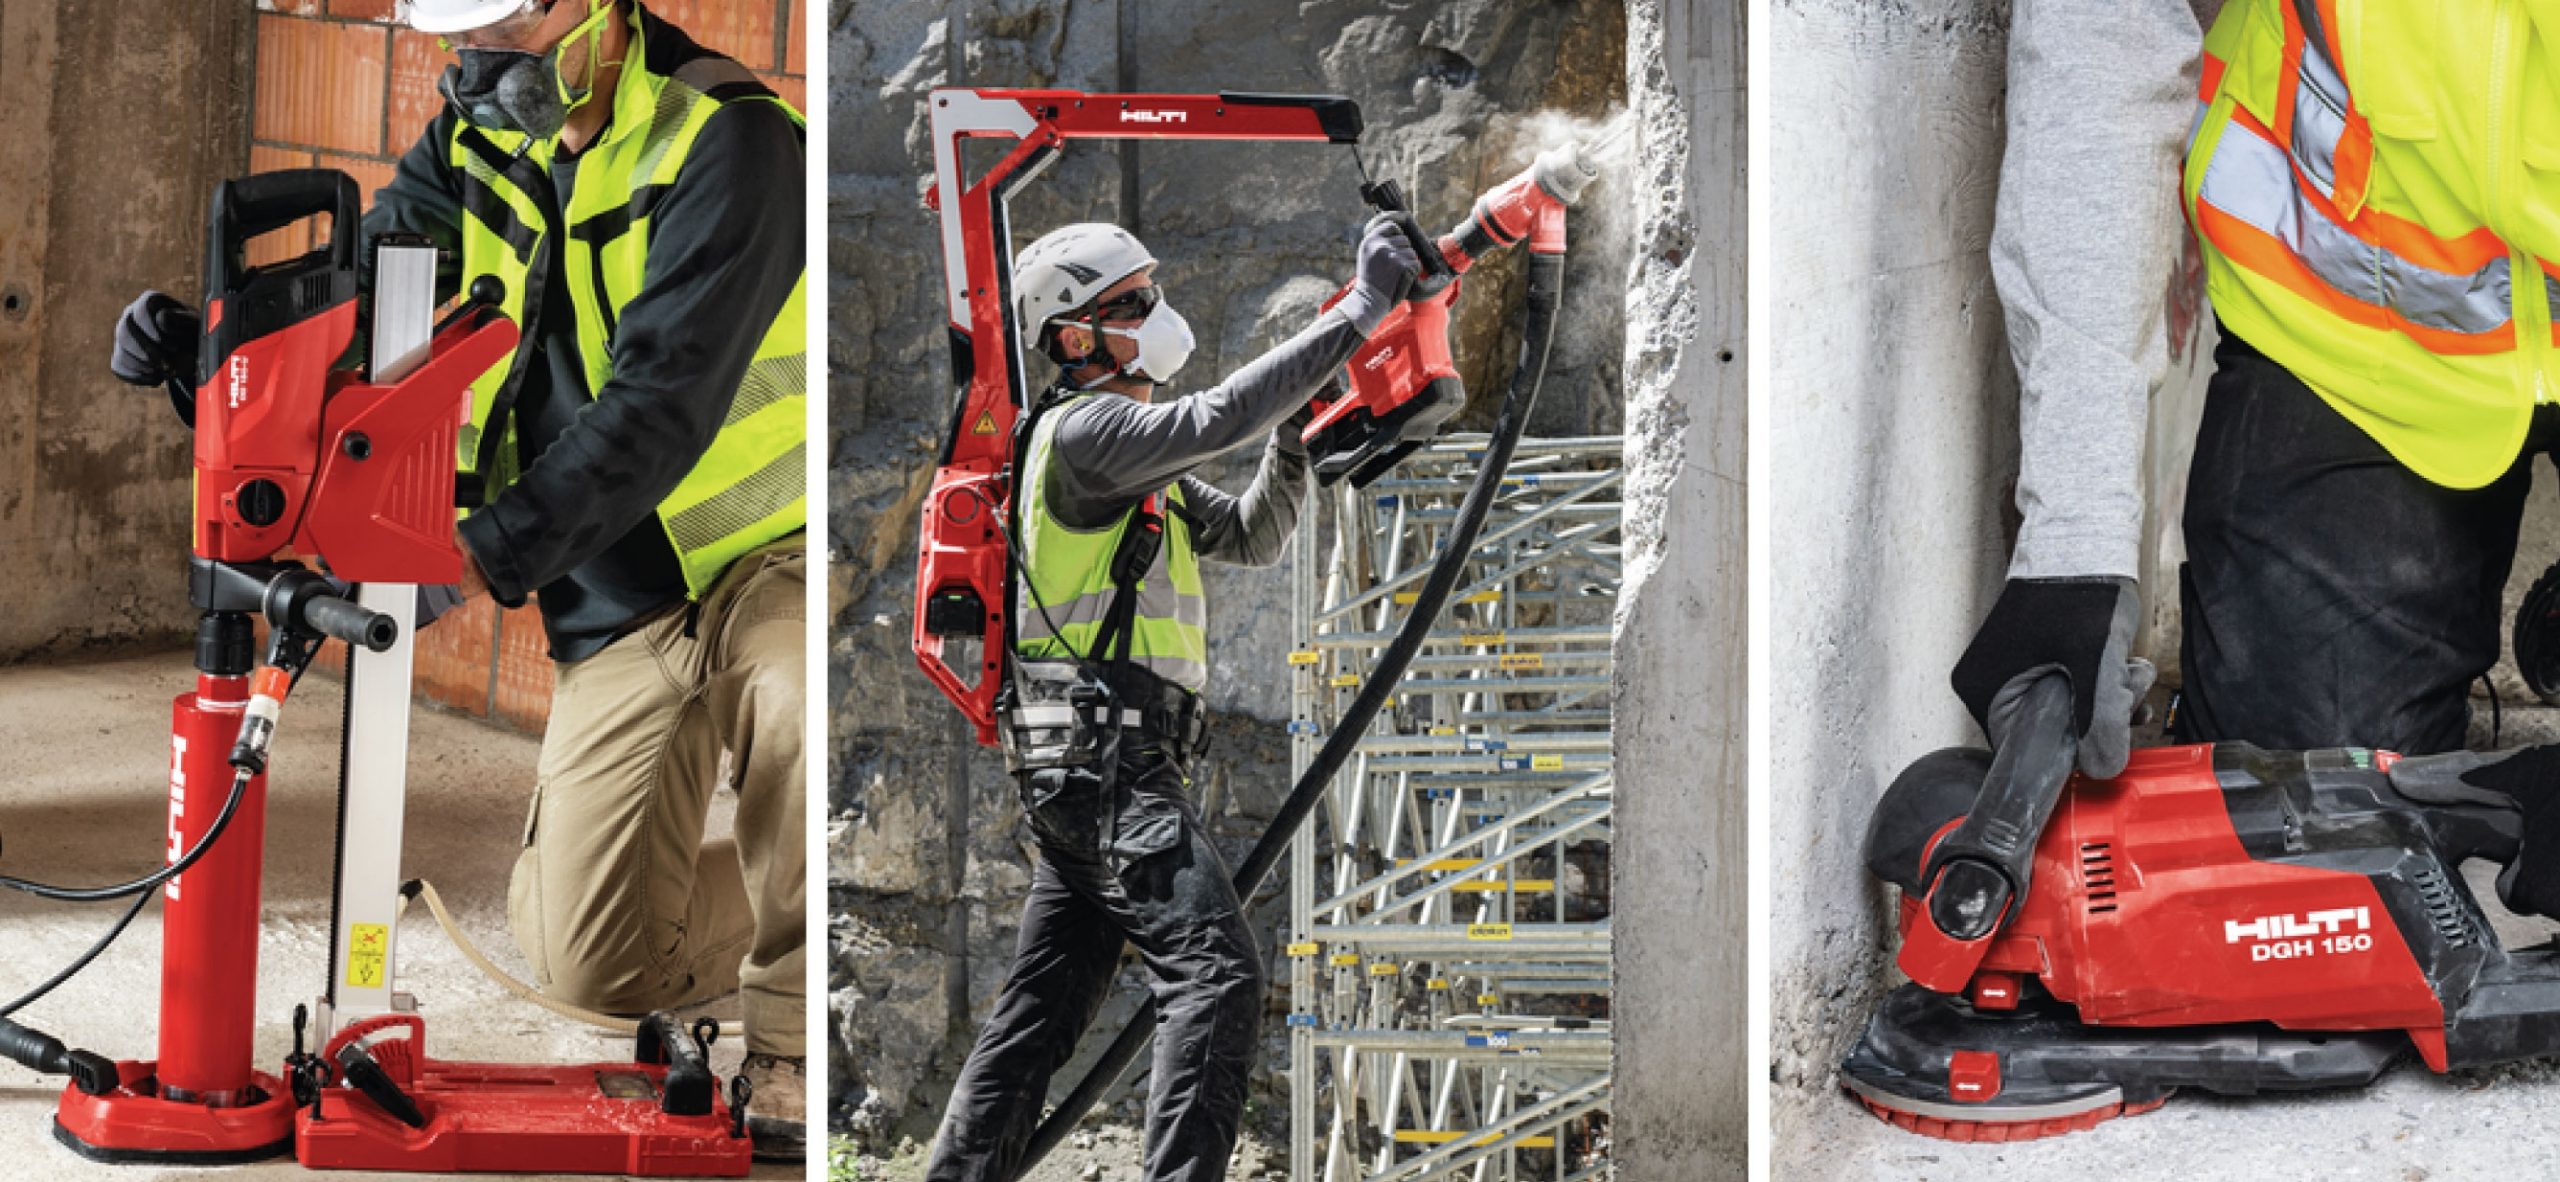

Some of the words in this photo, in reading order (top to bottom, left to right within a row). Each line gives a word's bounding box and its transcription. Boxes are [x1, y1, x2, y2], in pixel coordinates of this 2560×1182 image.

[1121, 109, 1187, 122] HILTI
[228, 355, 240, 408] HILTI
[165, 734, 187, 901] HILTI
[2225, 906, 2370, 943] HILTI
[2252, 939, 2314, 962] DGH
[2320, 933, 2374, 954] 150
